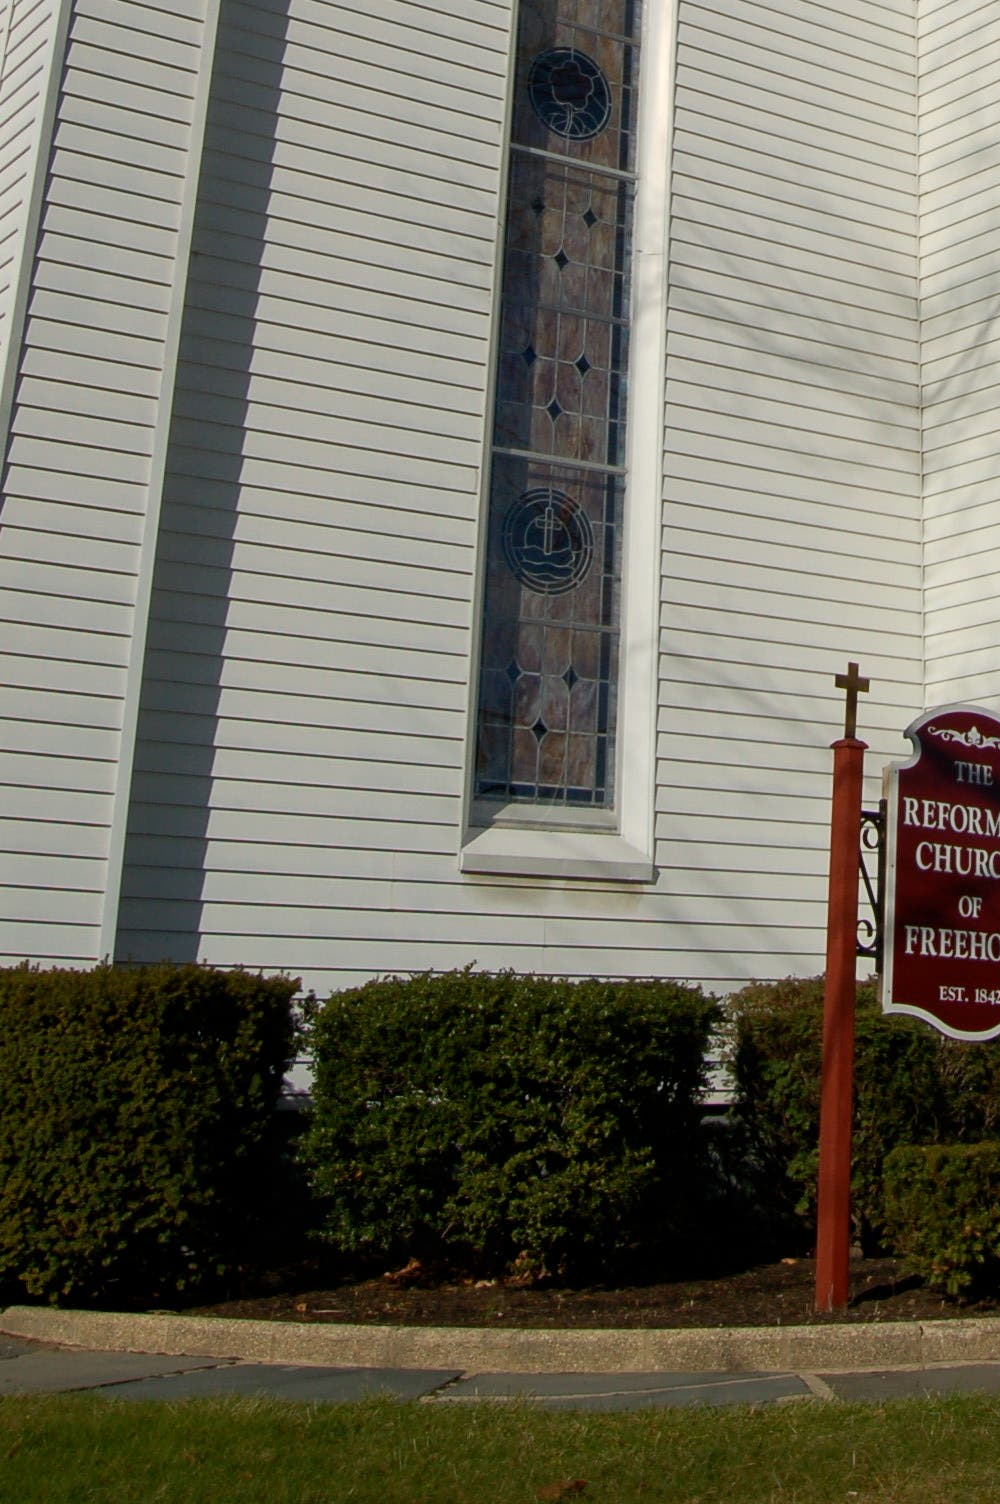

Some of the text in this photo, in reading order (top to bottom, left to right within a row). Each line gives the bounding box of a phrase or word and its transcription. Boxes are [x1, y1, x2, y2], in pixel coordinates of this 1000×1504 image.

[954, 760, 994, 786] THE
[958, 895, 983, 918] OF
[939, 986, 969, 1002] EST.
